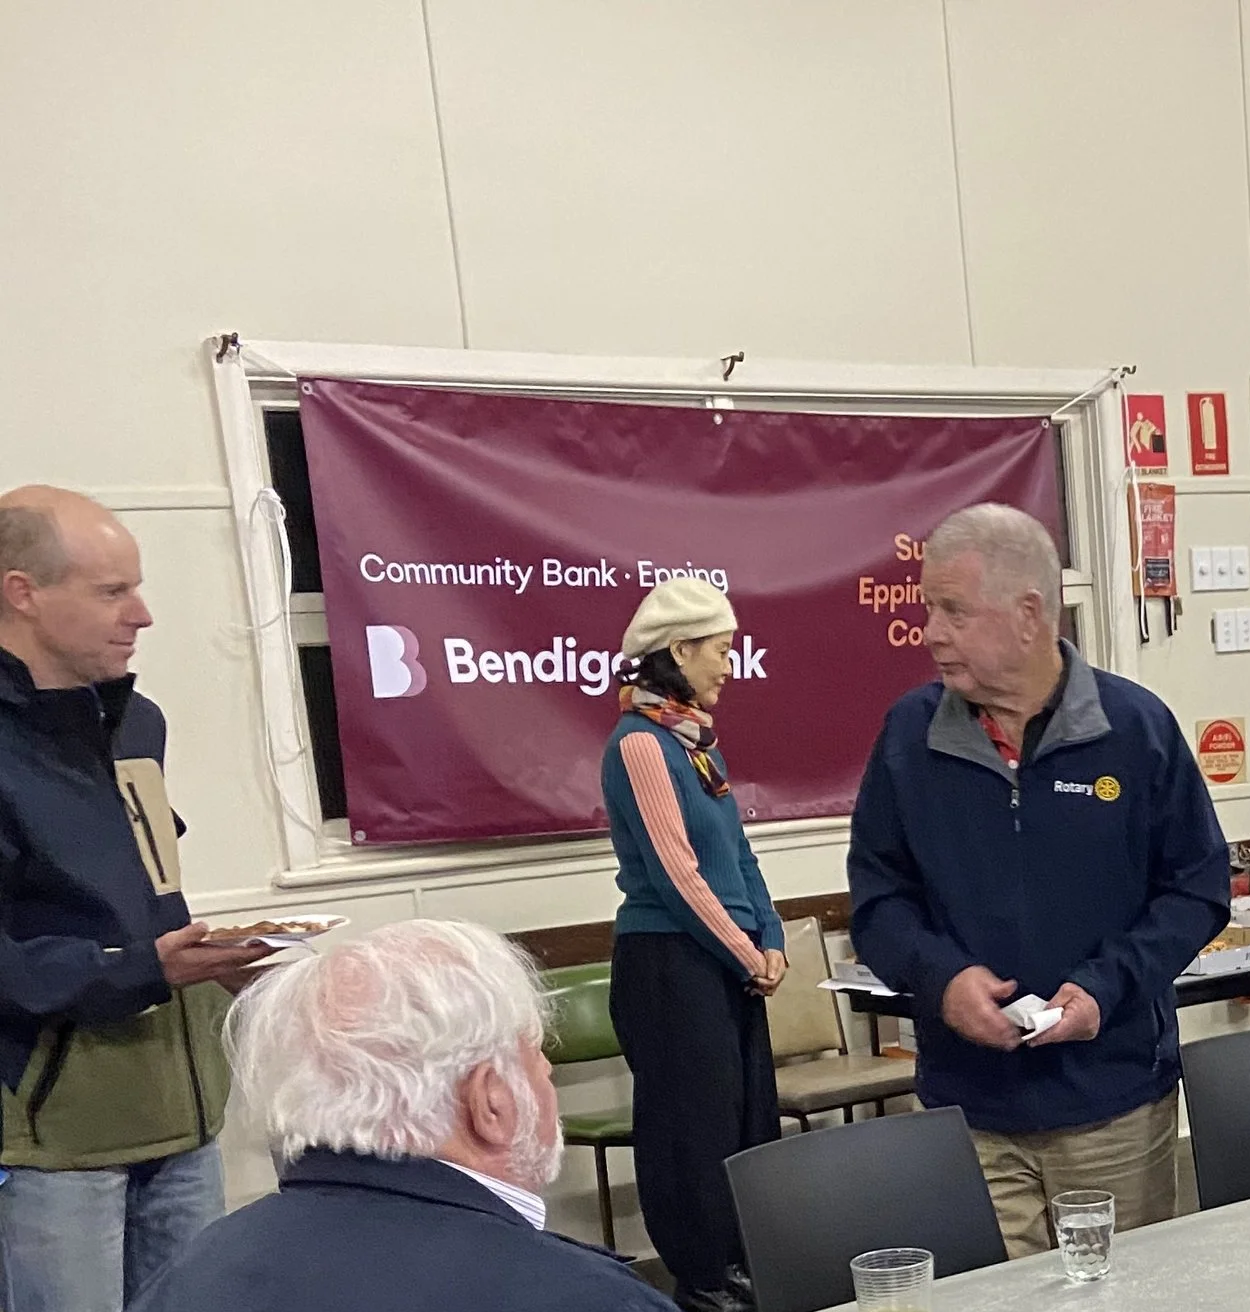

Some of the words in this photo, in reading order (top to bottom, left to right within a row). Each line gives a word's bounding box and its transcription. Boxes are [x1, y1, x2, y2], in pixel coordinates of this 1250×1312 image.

[360, 553, 533, 595] Community
[542, 558, 618, 587] Bank
[858, 575, 926, 614] Eppin
[1054, 781, 1094, 796] Rotary
